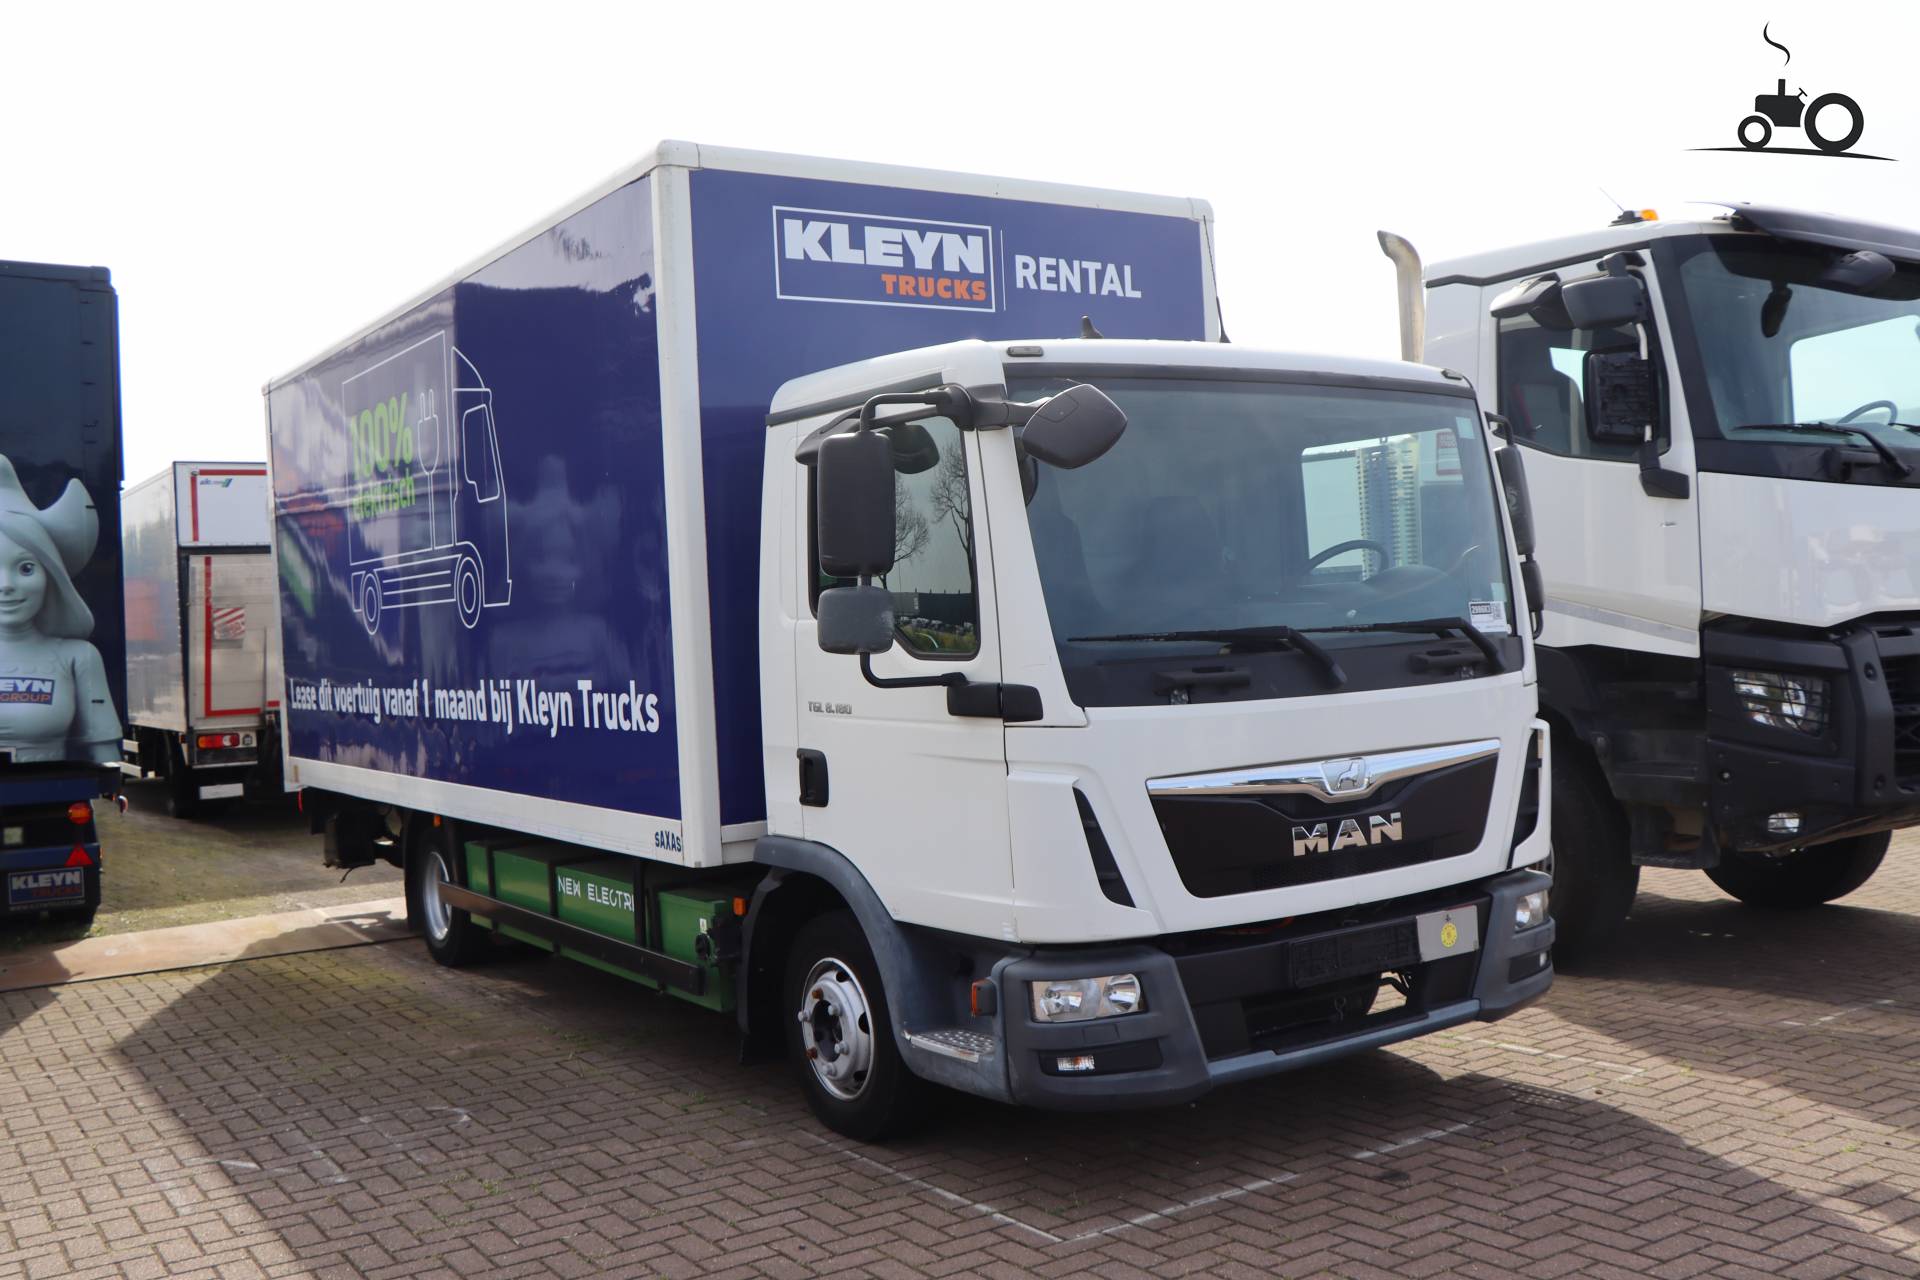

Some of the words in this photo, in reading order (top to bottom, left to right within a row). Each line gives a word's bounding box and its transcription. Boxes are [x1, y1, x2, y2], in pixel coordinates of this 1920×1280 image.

[783, 218, 985, 274] KLEYN
[880, 273, 987, 301] TRUCKS
[1014, 254, 1142, 299] RENTAL
[350, 391, 414, 482] 100%
[352, 467, 416, 523] elektrisch
[290, 678, 317, 711] Lease
[318, 678, 333, 712] dit
[334, 678, 380, 725] voertuig
[382, 679, 419, 717] vanaf
[422, 678, 430, 718] 1
[434, 679, 487, 722] maand
[489, 679, 513, 735] bij
[516, 679, 574, 738] Kleyn
[577, 680, 660, 733] Trucks
[655, 830, 682, 852] SAXAS
[1292, 812, 1402, 857] MAN
[11, 870, 80, 890] KLEYN
[557, 873, 581, 898] NEW
